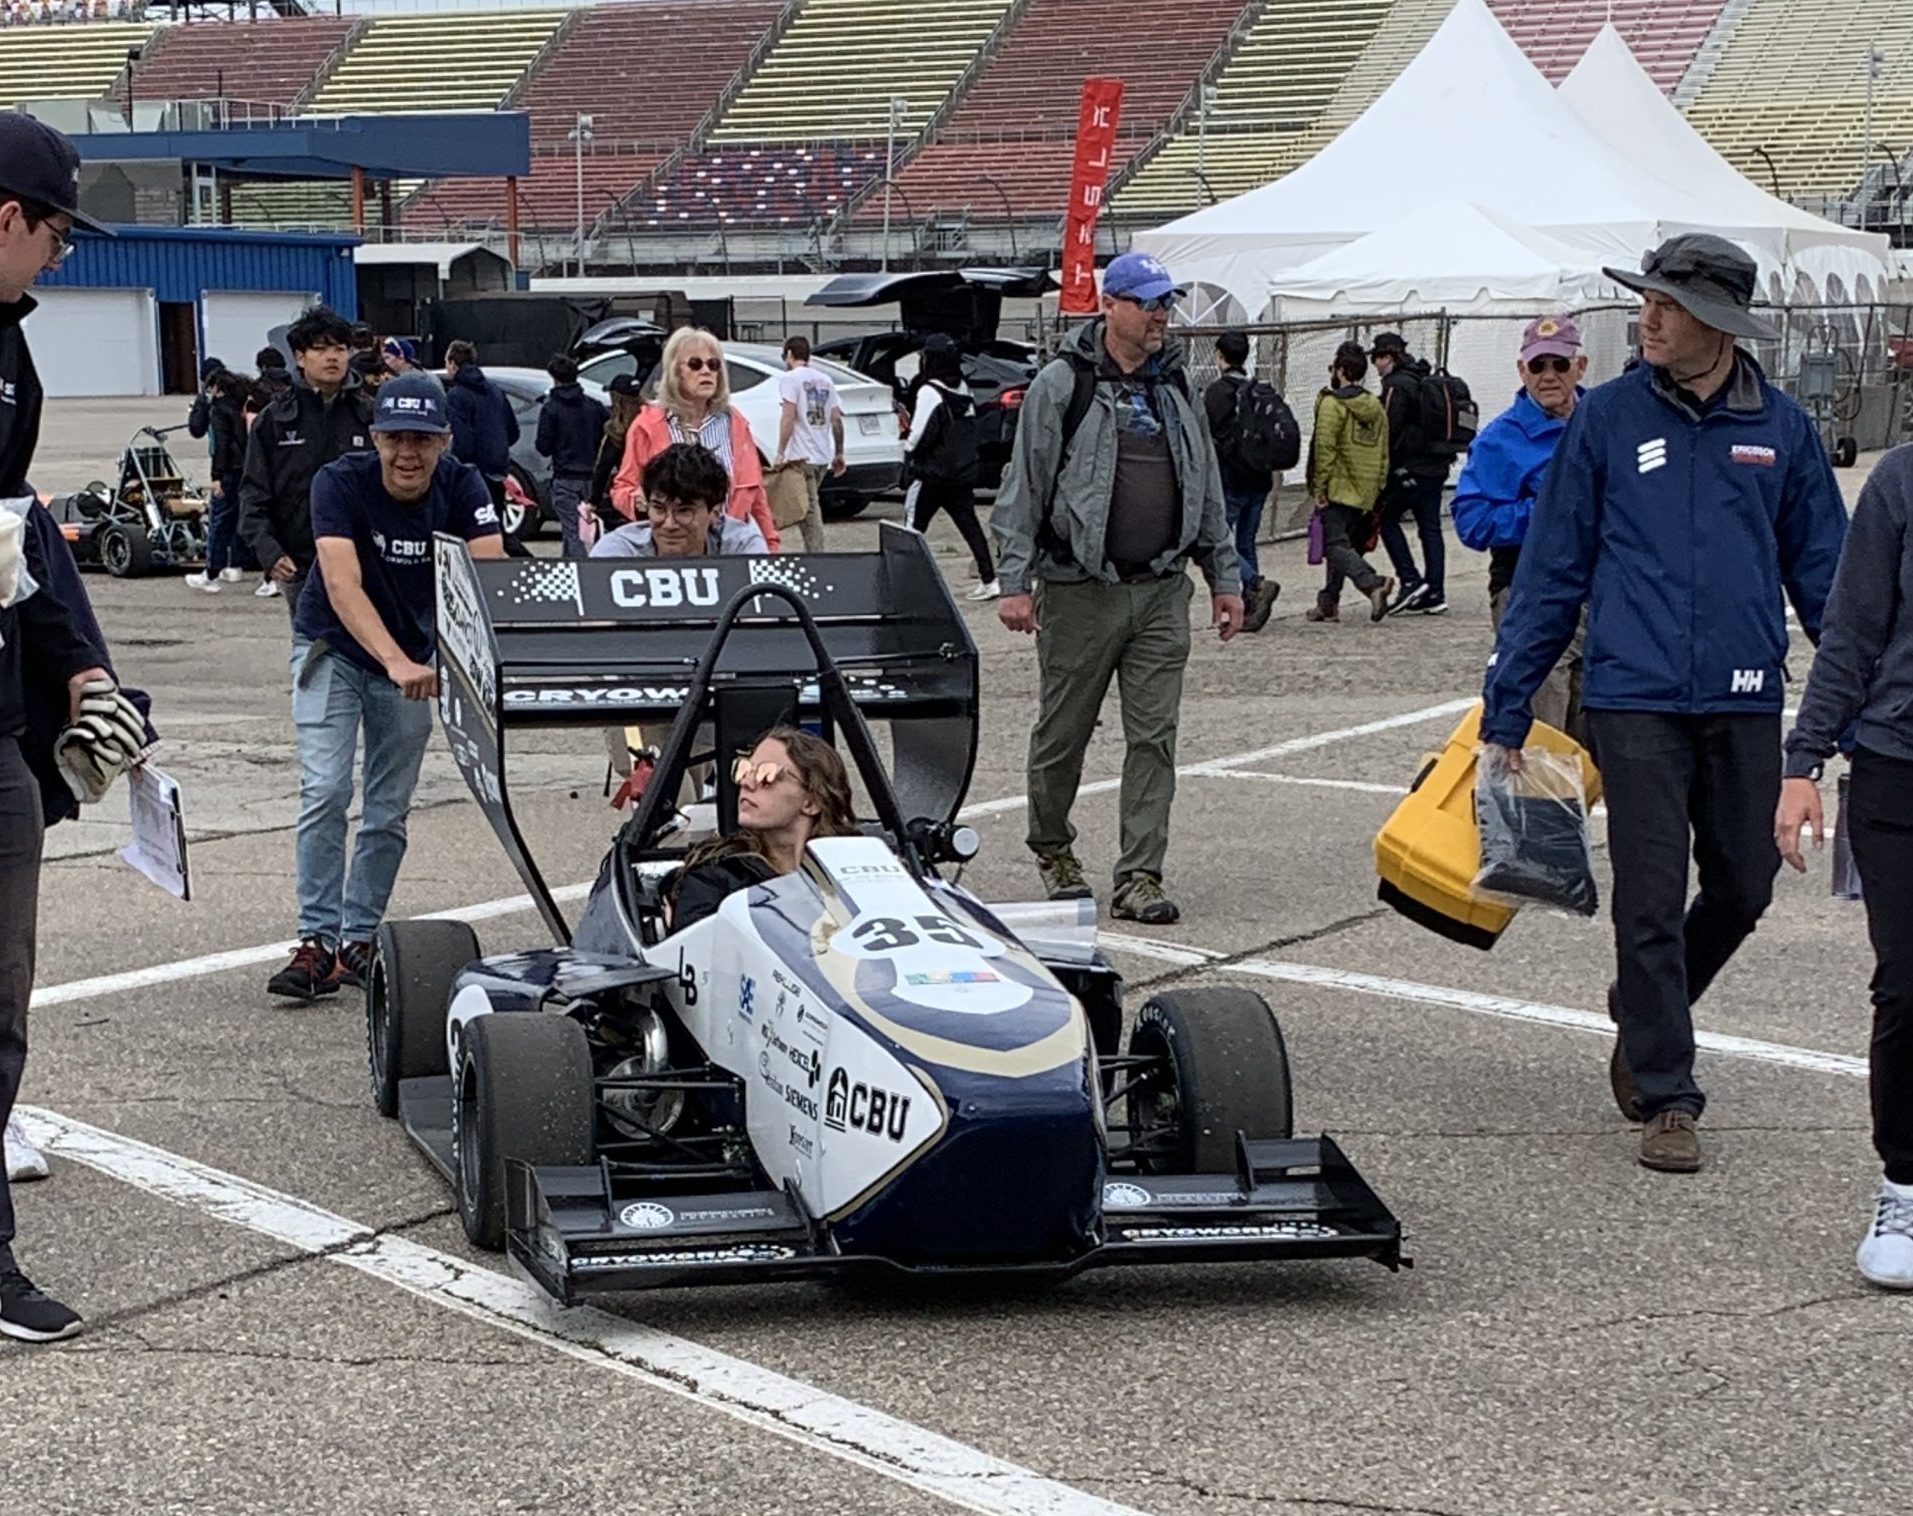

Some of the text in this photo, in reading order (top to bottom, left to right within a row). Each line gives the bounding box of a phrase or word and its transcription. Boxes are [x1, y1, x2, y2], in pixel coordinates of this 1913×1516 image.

[391, 539, 427, 556] CBU
[610, 568, 719, 608] CBU
[502, 687, 691, 702] CRYOW
[1730, 668, 1764, 693] HH
[852, 915, 985, 952] 35
[784, 1084, 818, 1121] SIEMENS
[850, 1081, 912, 1144] CBU
[1122, 1226, 1298, 1240] CRYOWORKS
